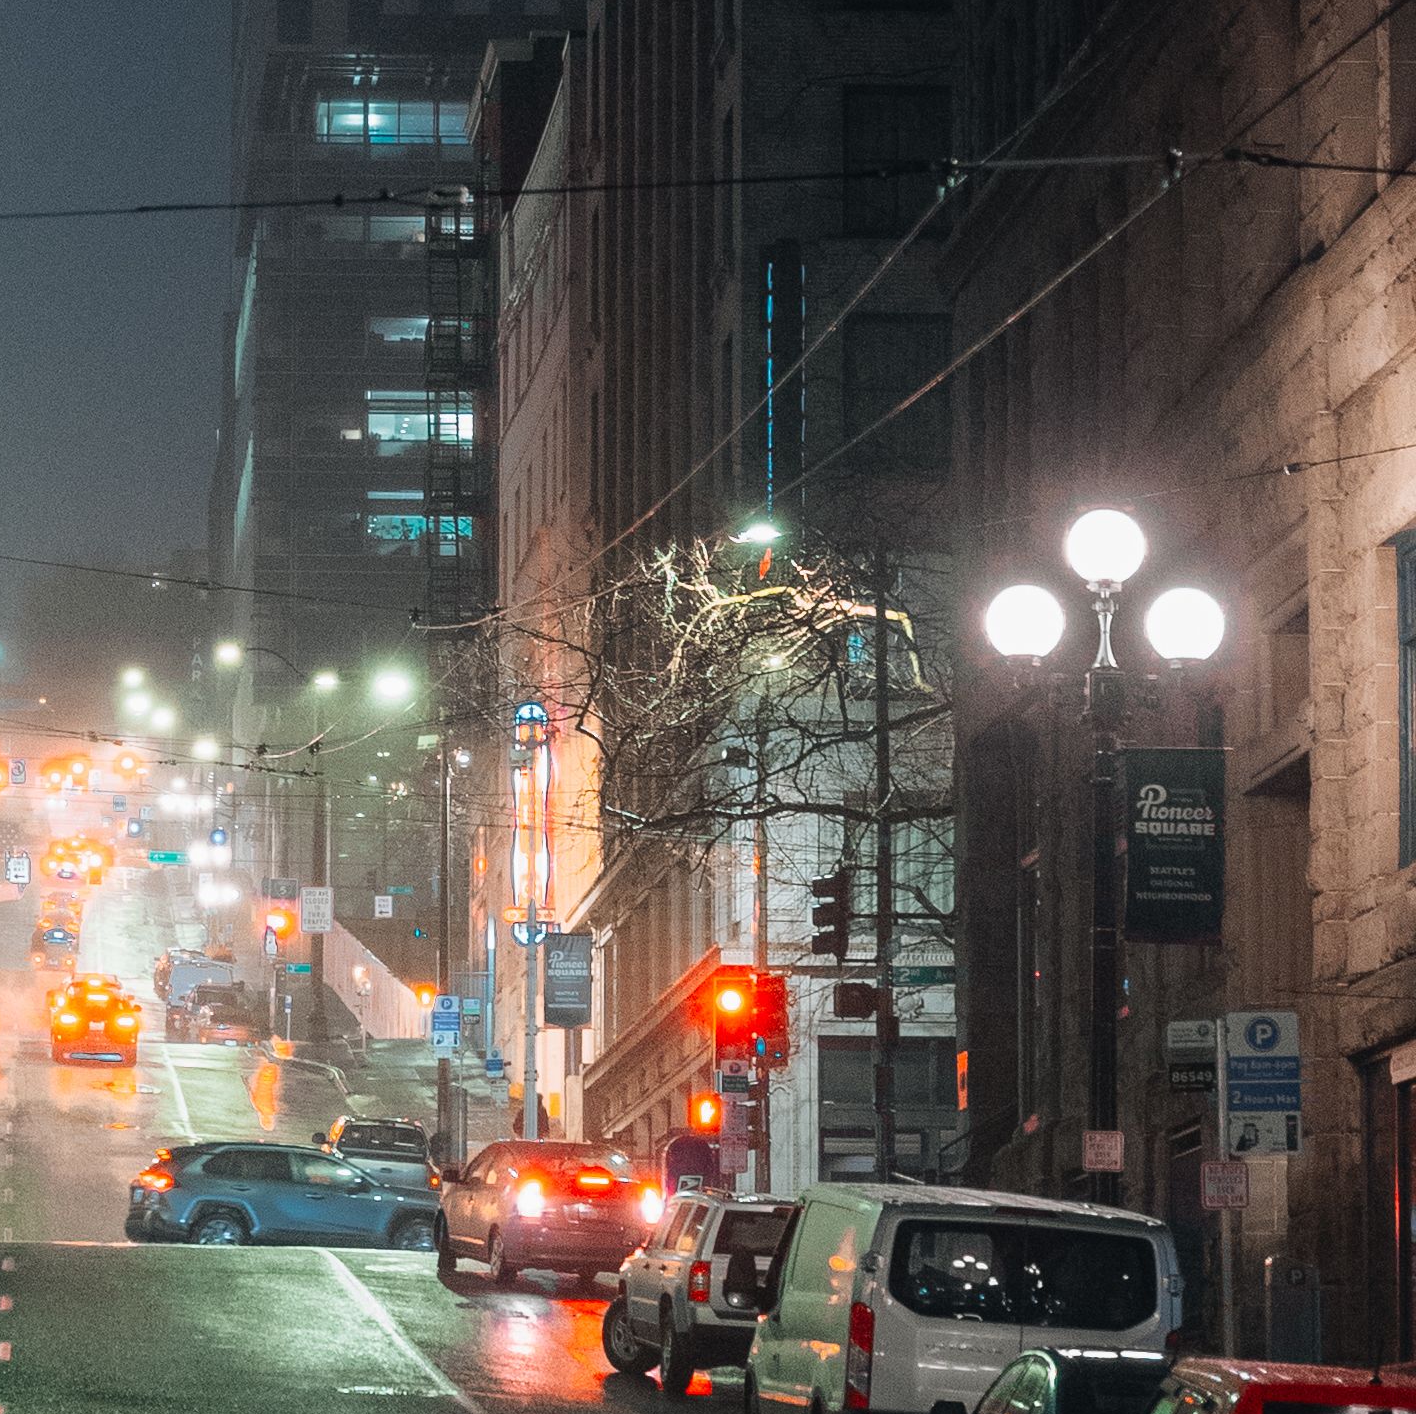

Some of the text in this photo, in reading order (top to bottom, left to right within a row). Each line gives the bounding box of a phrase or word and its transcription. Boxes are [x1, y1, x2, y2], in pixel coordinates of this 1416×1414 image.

[1136, 784, 1215, 820] Pioneer
[1135, 821, 1215, 836] SQUARE
[1149, 866, 1196, 876] SEATTLE'S
[1149, 879, 1195, 888] ORIGINAL
[1135, 891, 1213, 902] NEIGHBORHOOD
[548, 951, 587, 969] Pioneer
[1230, 1060, 1247, 1072] Pay
[1171, 1070, 1213, 1083] 86549
[1232, 1091, 1241, 1104] 2
[1244, 1095, 1274, 1104] Hours
